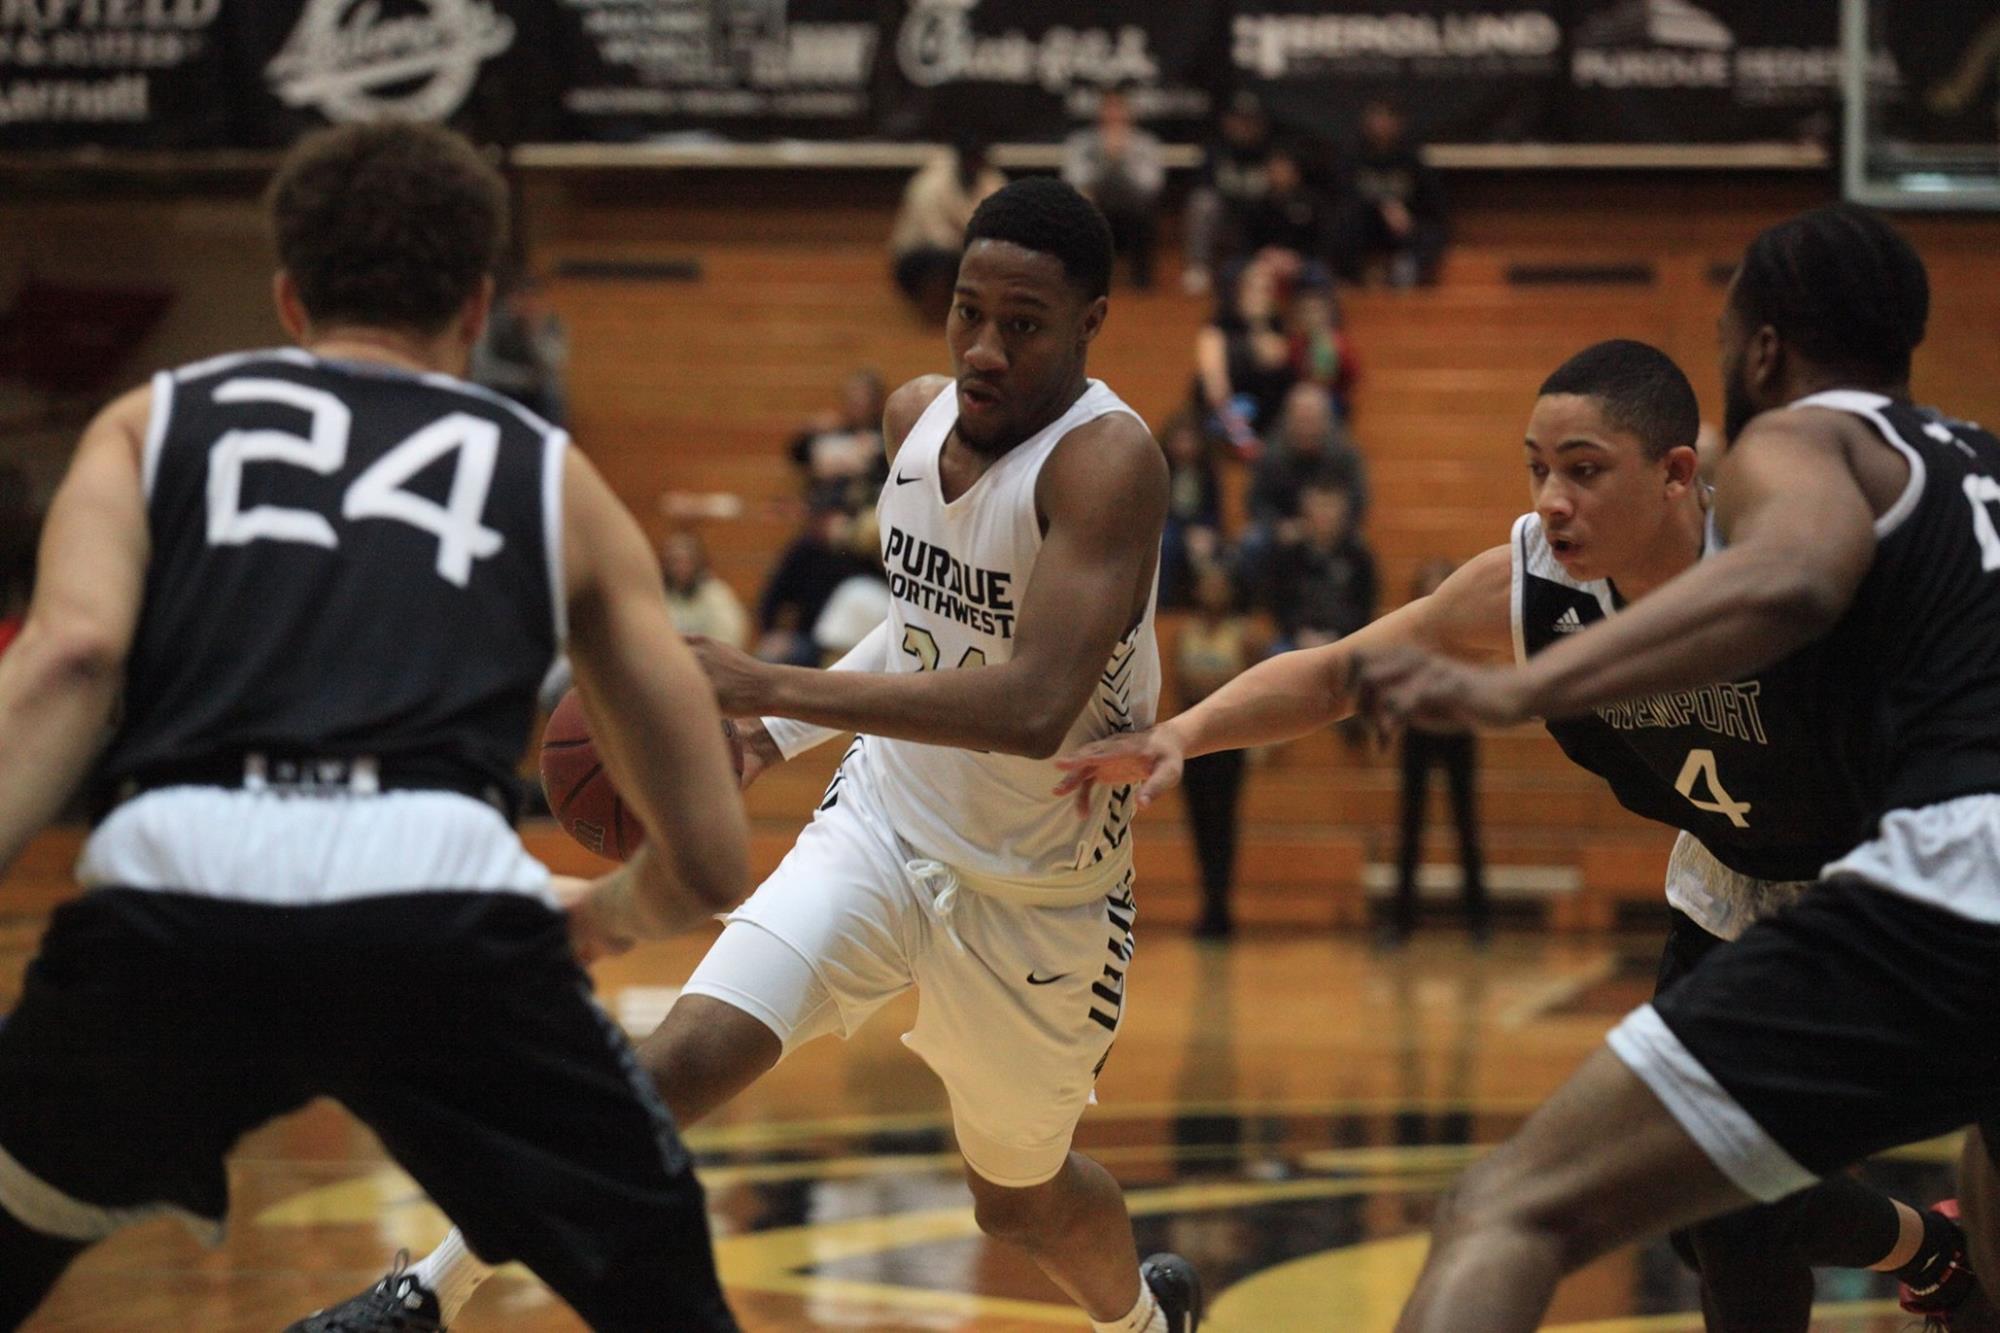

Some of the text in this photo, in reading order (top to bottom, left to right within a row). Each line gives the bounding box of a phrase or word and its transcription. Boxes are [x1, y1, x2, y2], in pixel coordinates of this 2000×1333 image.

[206, 377, 504, 589] 24
[884, 527, 1014, 611] PURDUE
[887, 569, 1015, 638] ORTHWEST
[1674, 749, 1751, 829] 4
